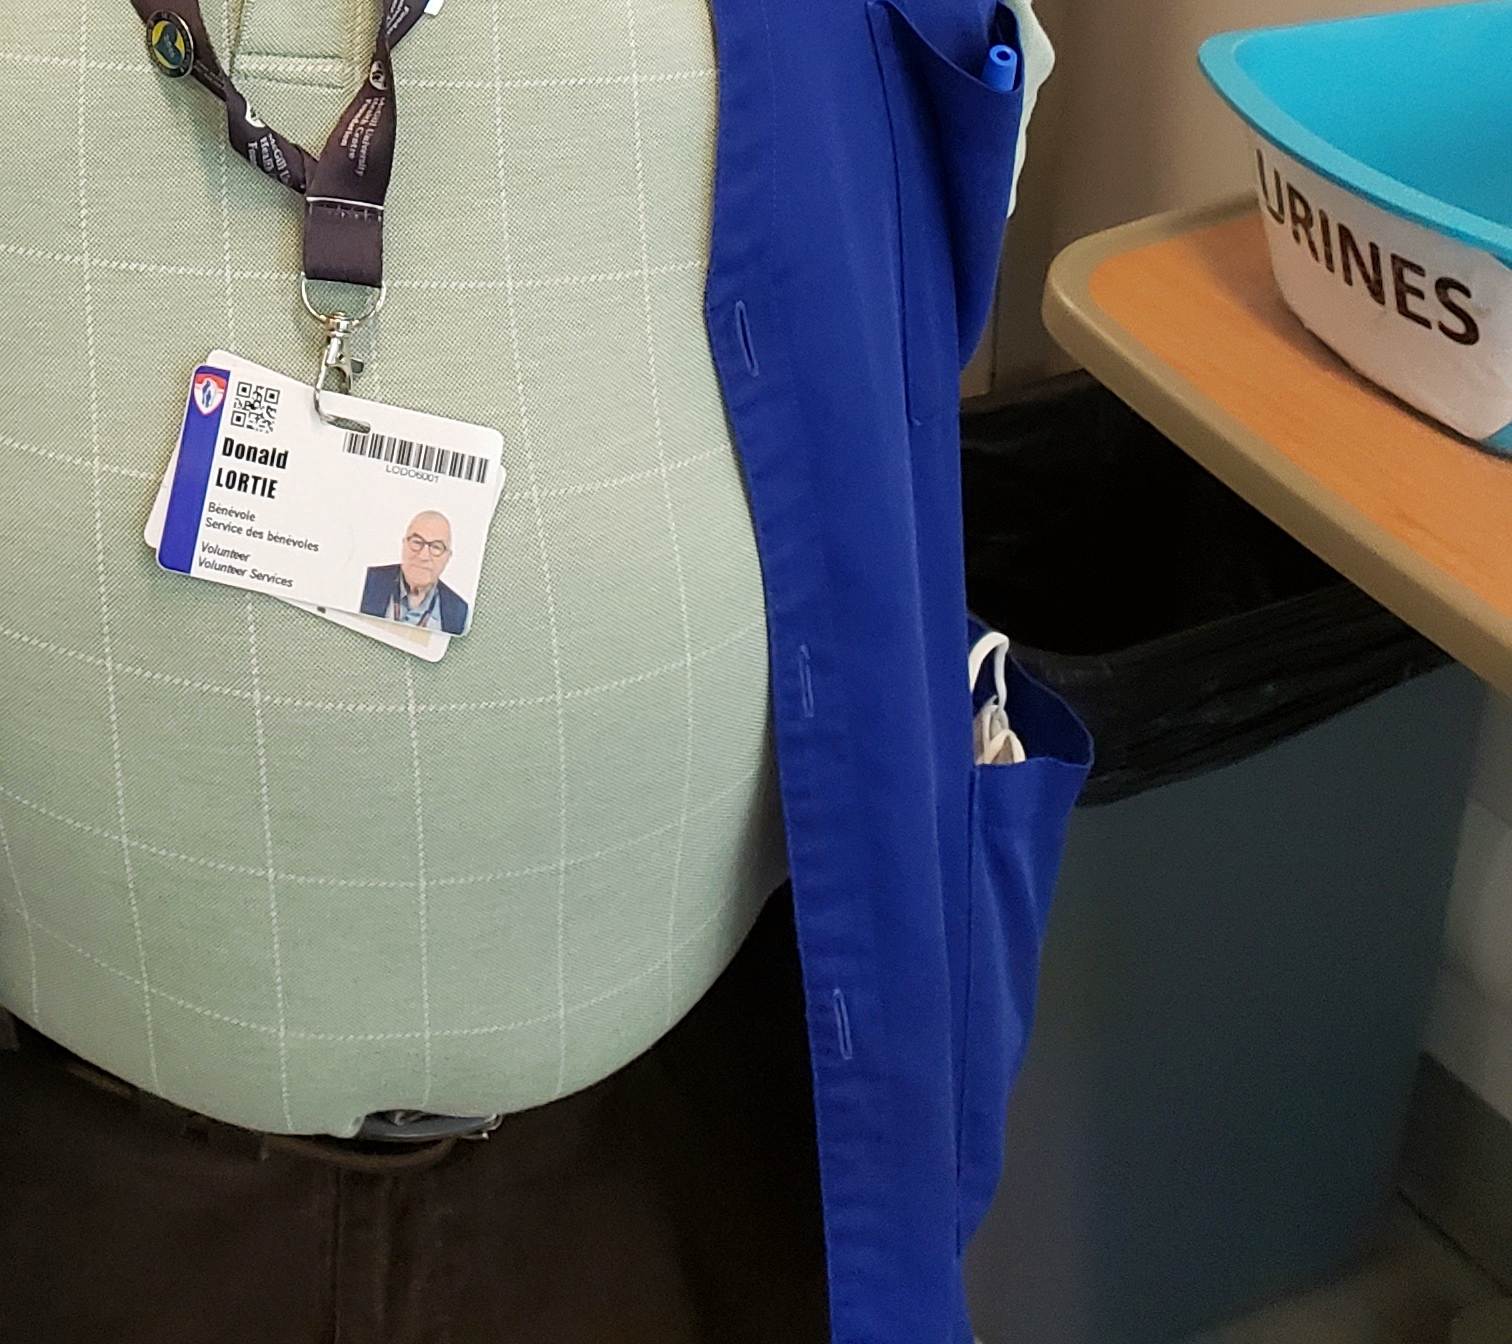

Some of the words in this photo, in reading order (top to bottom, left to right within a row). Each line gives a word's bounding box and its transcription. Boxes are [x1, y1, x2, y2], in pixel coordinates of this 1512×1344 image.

[1255, 147, 1481, 347] URINES
[221, 436, 289, 470] Donald
[215, 467, 278, 500] LORTIE
[208, 501, 256, 522] Bénévole
[205, 516, 243, 535] Service
[245, 526, 264, 540] des
[266, 530, 320, 552] bénévoles
[200, 541, 251, 562] Volunteer
[198, 555, 248, 577] Volunteer
[249, 568, 294, 588] Services
